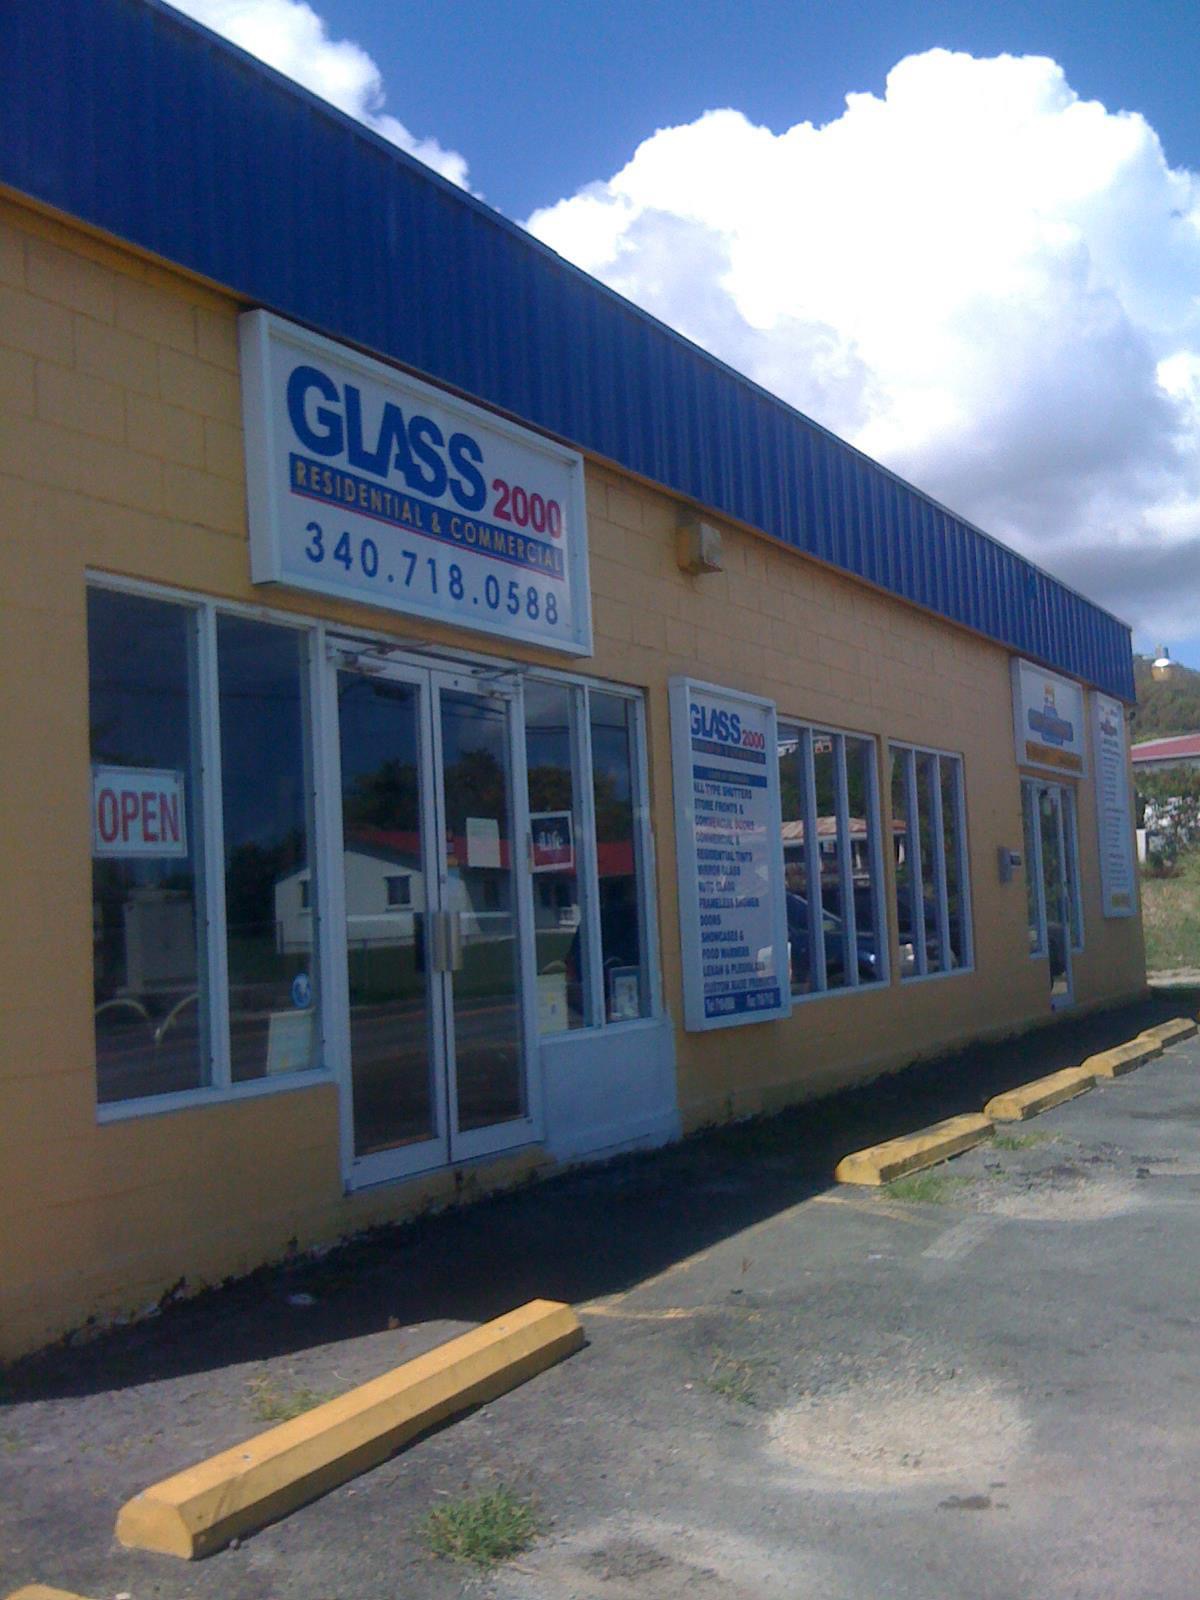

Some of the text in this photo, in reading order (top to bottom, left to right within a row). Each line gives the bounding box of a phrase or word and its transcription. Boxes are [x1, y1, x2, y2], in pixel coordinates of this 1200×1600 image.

[287, 365, 562, 539] GLASS 2000
[295, 461, 561, 572] RESIDENTIAL & COMMERCIAL
[304, 521, 558, 625] 340.718.0588
[690, 703, 765, 750] GLASS 2000
[98, 789, 180, 843] OPEN
